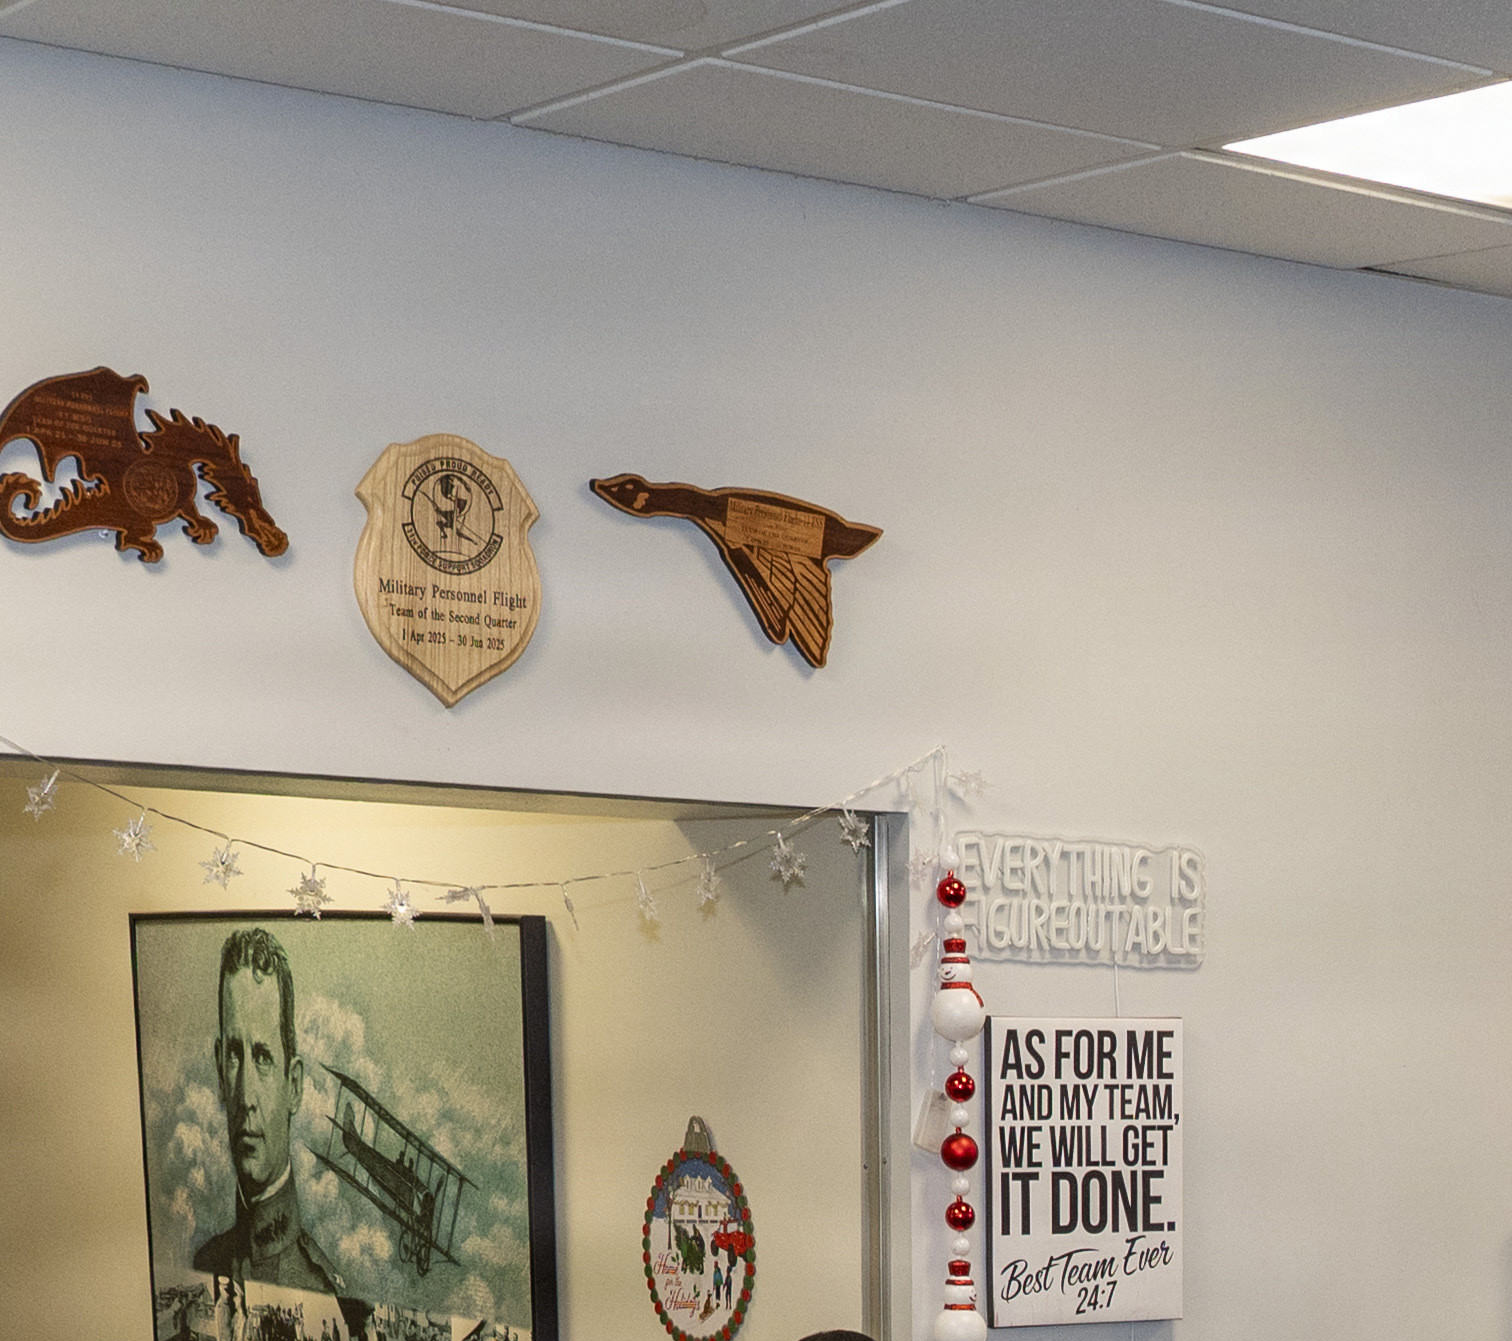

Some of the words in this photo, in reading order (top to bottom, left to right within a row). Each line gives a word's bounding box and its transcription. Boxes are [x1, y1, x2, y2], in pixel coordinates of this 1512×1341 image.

[379, 577, 426, 600] Military
[432, 584, 487, 605] Personnel
[493, 591, 527, 611] Flight
[389, 603, 414, 618] Team
[418, 606, 428, 620] of
[431, 609, 445, 622] the
[448, 611, 480, 626] Second
[484, 615, 517, 630] Quarter
[410, 629, 425, 644] Apr
[428, 630, 446, 644] 2025
[457, 634, 467, 647] 30
[470, 635, 483, 649] Jun
[487, 636, 505, 651] 2025
[959, 835, 1152, 898] EVERYTHING
[1168, 847, 1202, 901] IS
[1000, 1029, 1048, 1081] AS
[1053, 1028, 1119, 1079] FOR
[1126, 1030, 1175, 1079] ME
[1000, 1083, 1053, 1123] AND
[1059, 1083, 1099, 1122] MY
[1102, 1083, 1181, 1128] TEAM,
[999, 1126, 1043, 1169] WE
[1049, 1126, 1116, 1168] WILL
[1121, 1125, 1173, 1166] GET
[1000, 1172, 1042, 1237] IT
[1051, 1170, 1176, 1235] DONE.
[1000, 1258, 1053, 1304] Best
[1052, 1246, 1119, 1296] Team
[1123, 1235, 1174, 1279] Ever
[1075, 1281, 1118, 1316] 24:7
